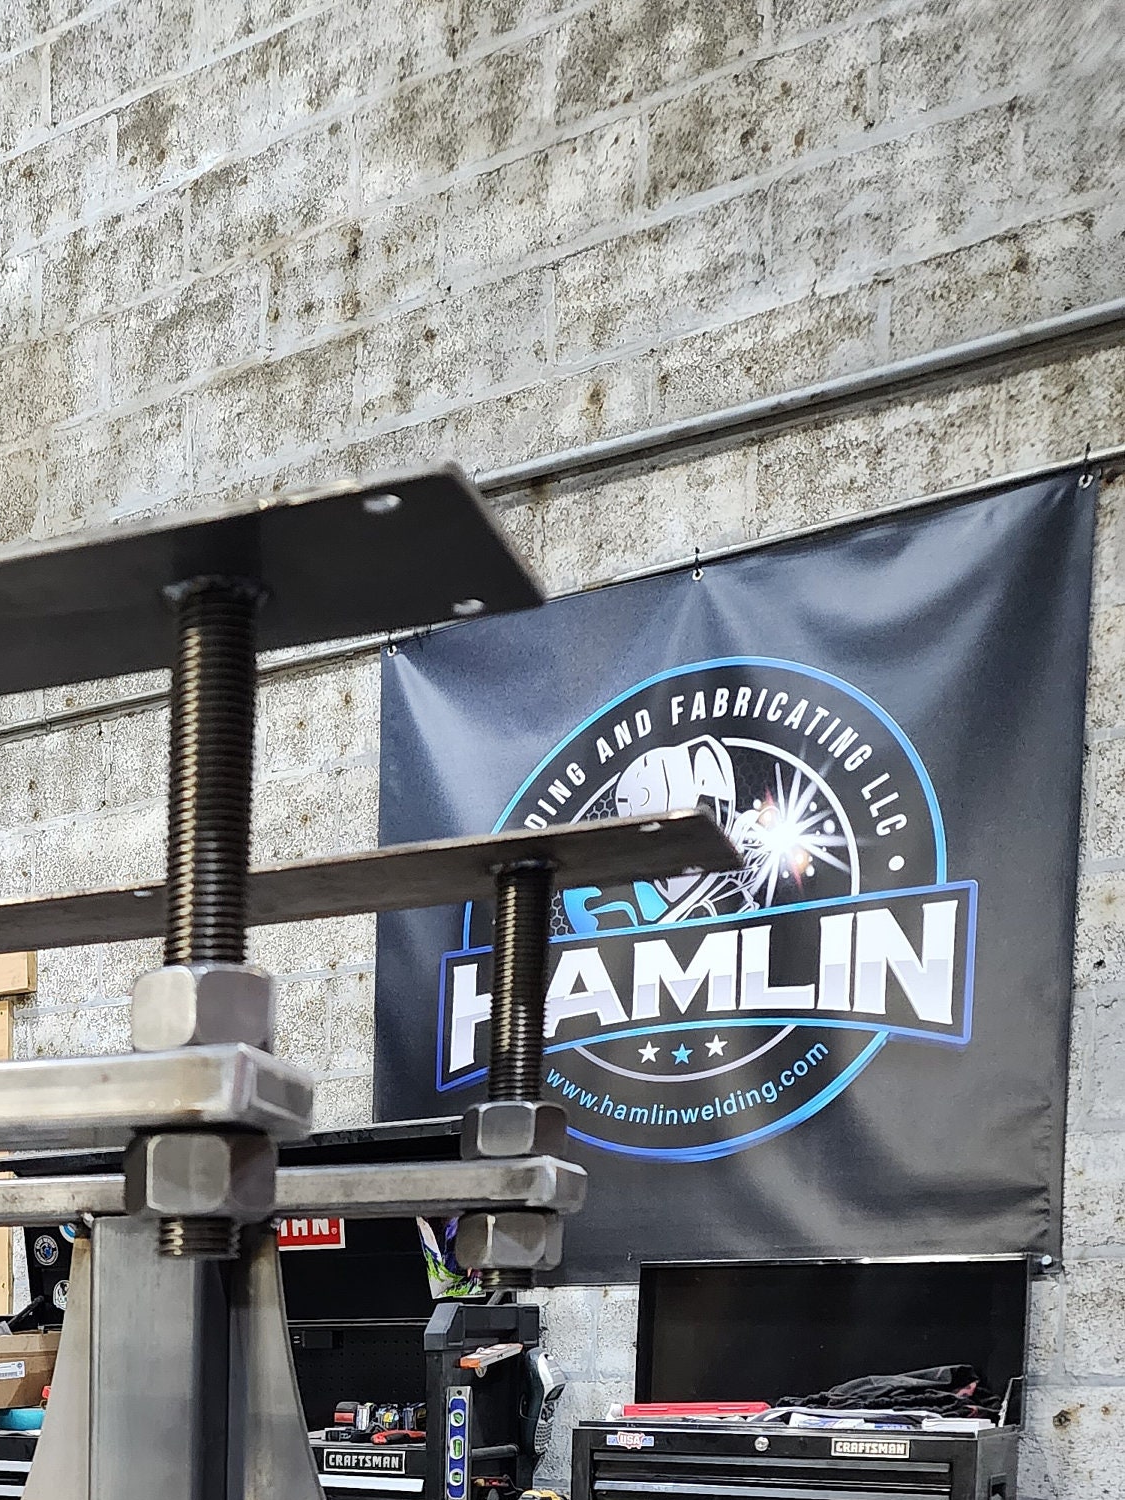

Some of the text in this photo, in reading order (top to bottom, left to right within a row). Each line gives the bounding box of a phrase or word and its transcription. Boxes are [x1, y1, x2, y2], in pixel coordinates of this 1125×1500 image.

[524, 687, 908, 836] DING AND FABRICATING LLC
[449, 899, 959, 1073] HAMLIN
[546, 1041, 830, 1126] www.hamlinwelding.com
[328, 1454, 400, 1469] CRAFTSMAN
[835, 1441, 905, 1455] CRAFTSMAN
